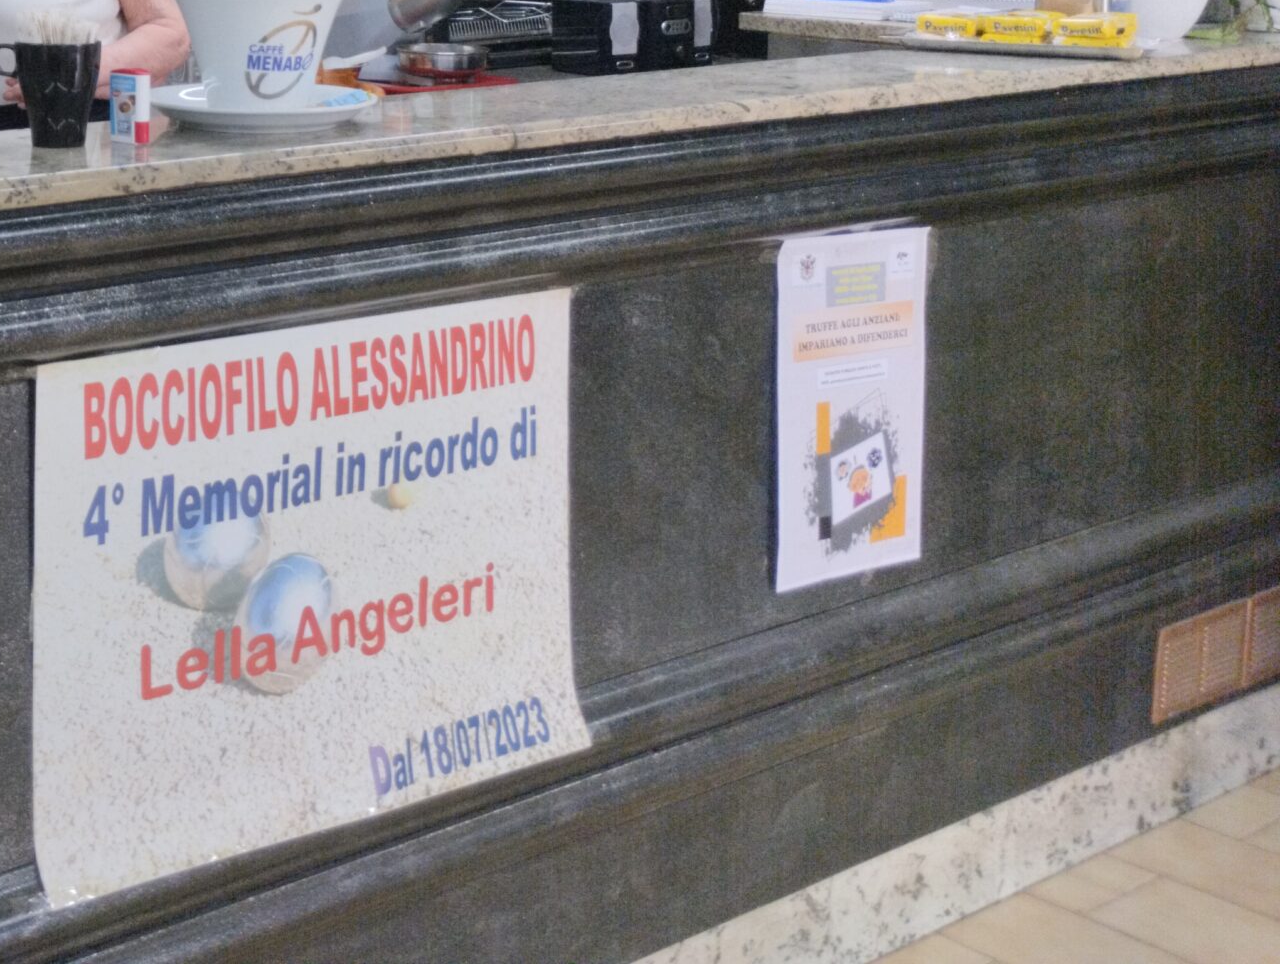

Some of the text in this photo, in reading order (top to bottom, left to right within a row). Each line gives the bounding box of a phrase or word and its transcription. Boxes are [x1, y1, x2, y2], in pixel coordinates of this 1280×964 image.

[798, 337, 848, 352] IMPARIAMO
[857, 328, 909, 344] DIFENDERCI
[805, 317, 839, 334] TRUFFE
[840, 315, 861, 330] AGLI
[83, 313, 536, 460] BOCCIOFILO ALESSANDRINO
[82, 405, 538, 546] 4° Memorial in ricordo di
[139, 562, 496, 701] Lella Angeleri
[368, 696, 551, 797] Dal 18/07/2023
